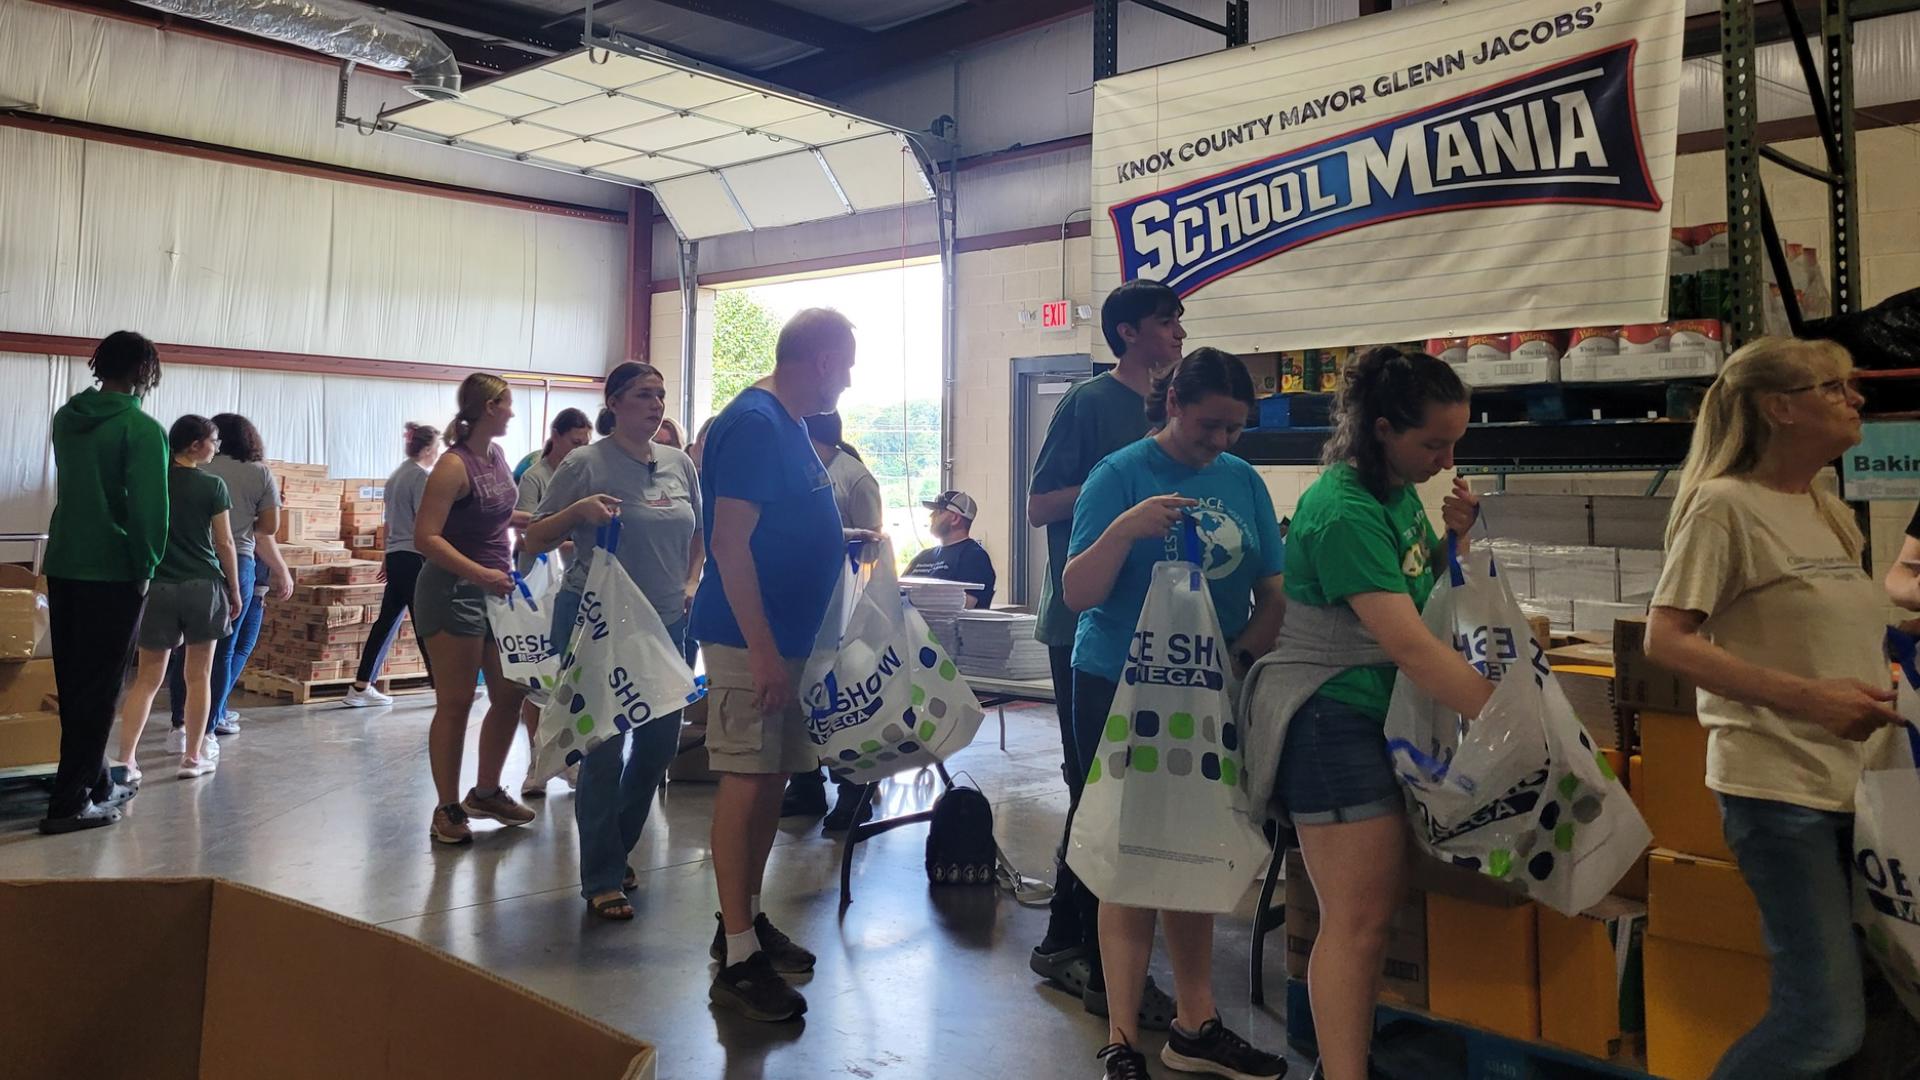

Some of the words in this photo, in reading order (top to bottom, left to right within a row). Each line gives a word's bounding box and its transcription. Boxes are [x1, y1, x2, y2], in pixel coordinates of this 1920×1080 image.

[1117, 151, 1176, 185] KNOX
[1177, 114, 1274, 163] COUNTY
[1280, 85, 1367, 128] MAYOR
[1373, 51, 1466, 98] GLENN
[1043, 303, 1067, 327] EXIT
[1168, 633, 1223, 671] SH
